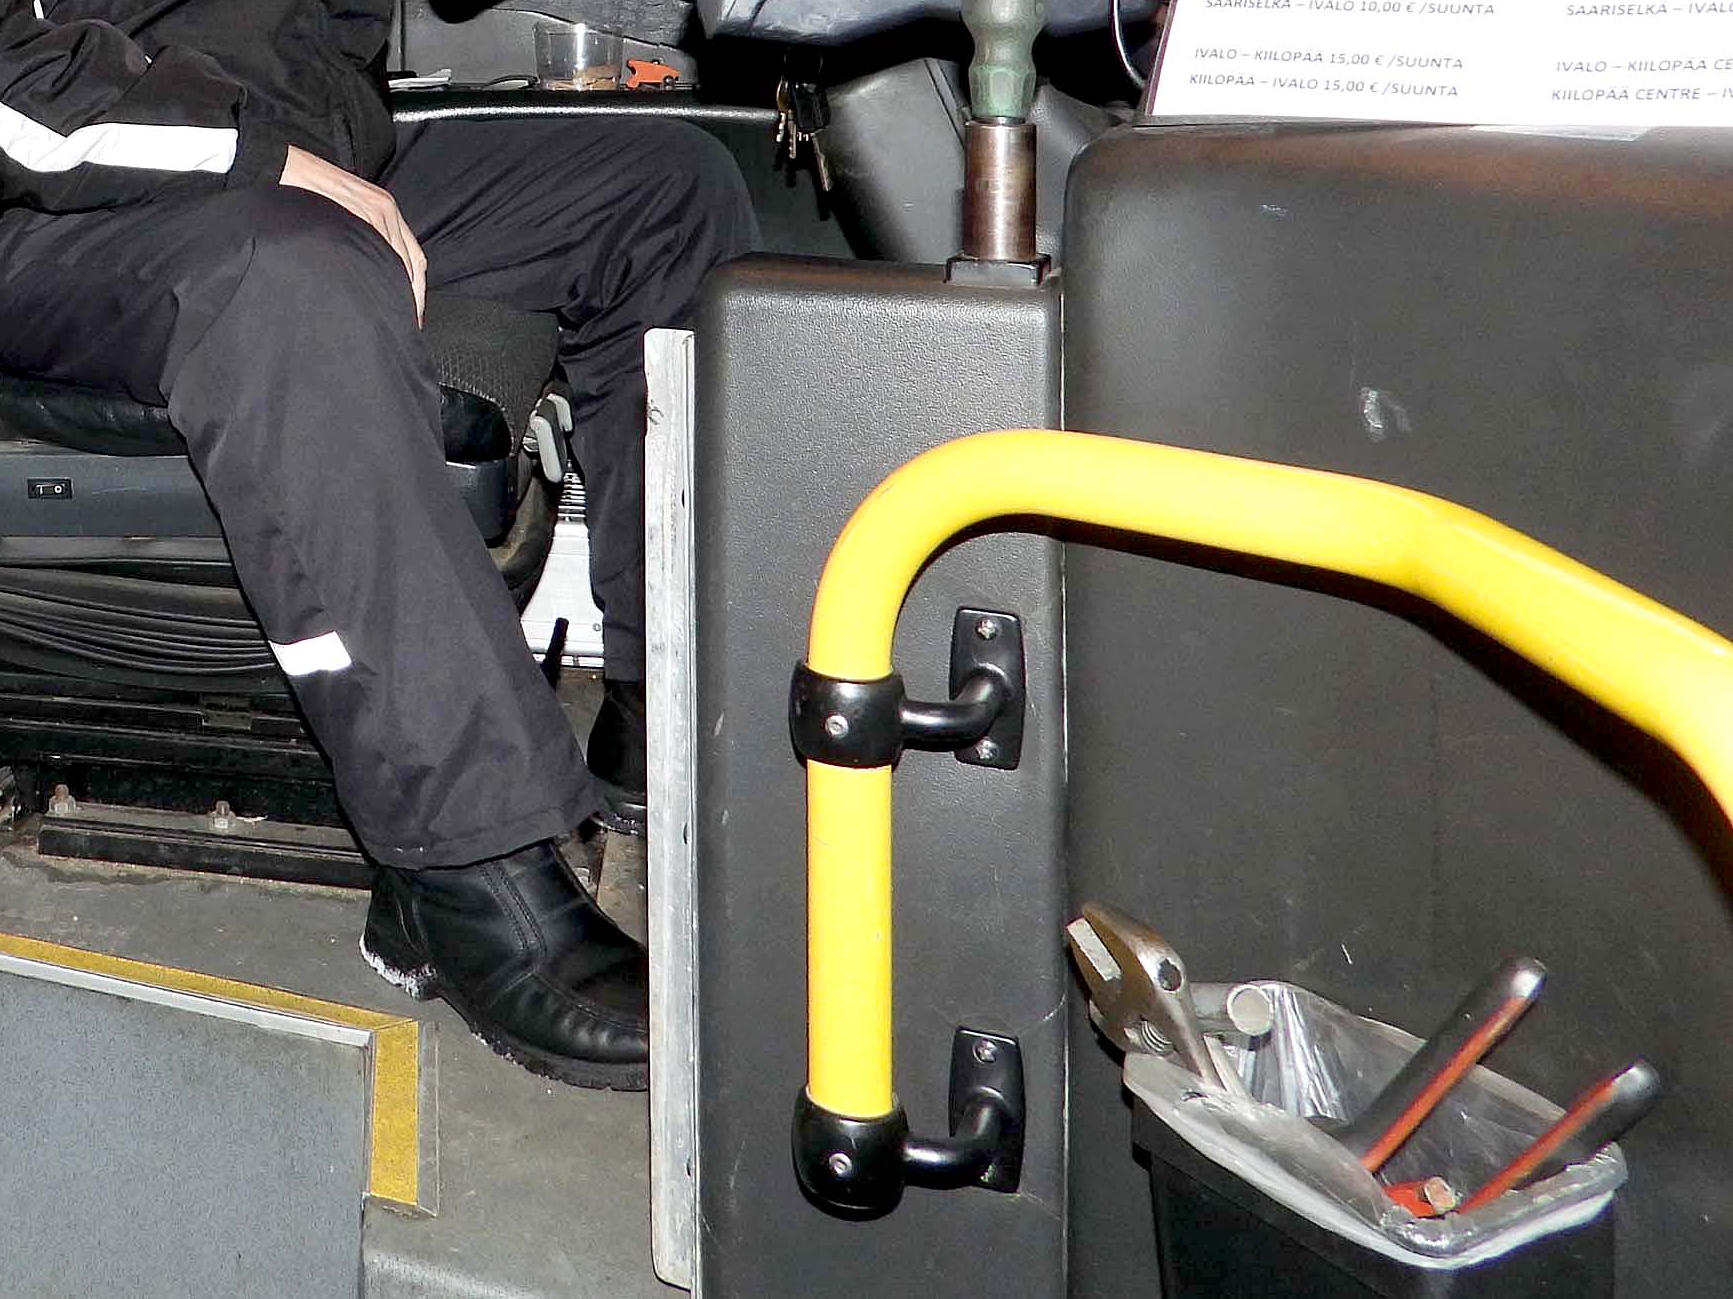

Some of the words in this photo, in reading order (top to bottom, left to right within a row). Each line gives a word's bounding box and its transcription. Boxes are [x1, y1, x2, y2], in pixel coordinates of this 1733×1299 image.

[1309, 0, 1354, 11] IVALO
[1361, 1, 1401, 13] 10,00
[1406, 2, 1414, 13] €
[1419, 2, 1495, 15] /SUUNTA
[1567, 2, 1667, 16] SAARISELKÄ
[1194, 48, 1237, 60] IVALO
[1330, 53, 1369, 66] 15,00
[1375, 55, 1383, 65] €
[1388, 55, 1463, 69] /SUUNTA
[1556, 61, 1607, 72] IVALO
[1628, 59, 1707, 71] KIILOPÄÄ
[1714, 59, 1733, 70] CE
[1273, 77, 1318, 90] IVALO
[1324, 80, 1364, 93] 15,00
[1370, 82, 1378, 92] €
[1383, 82, 1458, 97] /SUUNTA
[1552, 87, 1628, 101] KIILOPÄÄ
[1635, 88, 1700, 100] CENTRE
